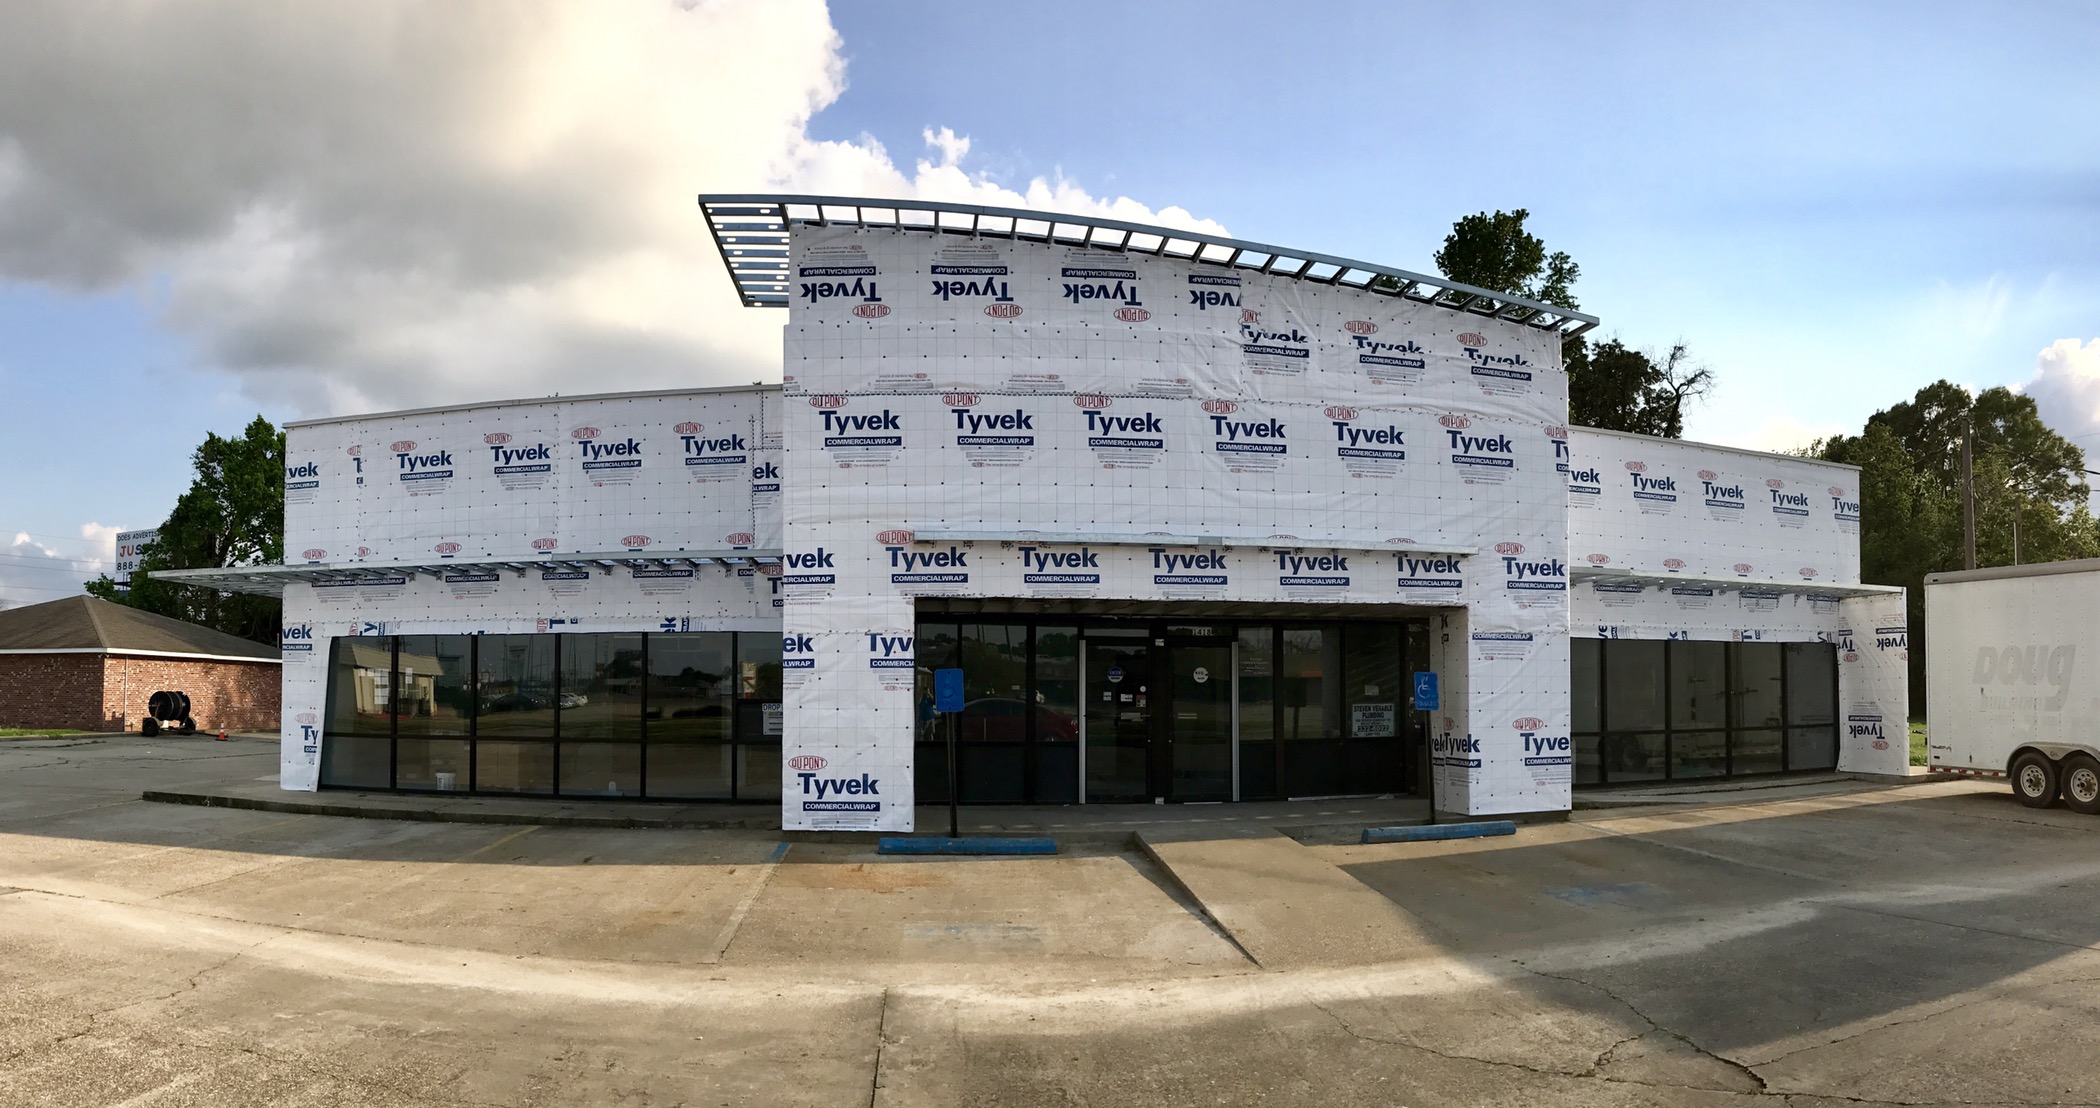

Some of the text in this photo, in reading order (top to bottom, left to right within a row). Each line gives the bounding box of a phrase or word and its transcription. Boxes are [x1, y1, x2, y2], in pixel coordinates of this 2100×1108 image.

[800, 278, 882, 302] Tyvek
[932, 277, 1013, 301] Tyvek
[1063, 281, 1142, 306] Tyvek
[1190, 290, 1241, 310] vek
[1353, 336, 1424, 354] Tyvek
[1360, 356, 1422, 368] COMMERCIALWRAP
[1464, 348, 1530, 367] Tyvek
[819, 410, 900, 435] Tyvek
[952, 409, 1033, 434] Tyvek
[1083, 410, 1162, 435] Tyvek
[1210, 415, 1286, 440] Tyvek
[826, 438, 897, 446] COMMERCIALWRAP
[959, 437, 1031, 445] COMMERCIALWRAP
[1090, 438, 1161, 448] COMMERCIALWRAP
[1333, 422, 1404, 446] Tyvek
[1447, 430, 1512, 453] Tyvek
[491, 444, 550, 464] Tyvek
[578, 438, 641, 460] Tyvek
[681, 434, 745, 456] Tyvek
[1217, 443, 1284, 453] COMMERCIALWRAP
[1339, 448, 1402, 459] COMMERCIALWRAP
[288, 462, 318, 478] vek
[397, 451, 451, 472] Tyvek
[495, 465, 549, 474] COMMERCIALWRAP
[583, 461, 640, 469] COMMERCIALWRAP
[686, 457, 744, 465] COMMERCIALWRAP
[1453, 456, 1511, 466] COMMERCIALWRAP
[1571, 468, 1600, 483] vek
[1630, 473, 1676, 491] Tyvek
[1703, 482, 1744, 499] Tyvek
[1770, 490, 1808, 506] Tyvek
[1832, 497, 1859, 513] Tyve
[133, 531, 157, 539] ADVERTIS
[120, 544, 142, 557] JUS
[784, 548, 834, 568] vek
[886, 547, 967, 571] Tyvek
[1018, 547, 1098, 572] Tyvek
[1148, 549, 1226, 573] Tyvek
[1274, 551, 1348, 575] Tyvek
[1393, 553, 1461, 576] Tyvek
[1502, 557, 1565, 579] Tyvek
[784, 575, 832, 583] ERCIALWRAP
[1156, 576, 1224, 584] COMMERCIALWRAP
[1281, 577, 1347, 585] COMMERCIALWRAP
[1399, 579, 1460, 587] COMMERCIALWRAP
[1508, 581, 1564, 590] COMMERCIALWRAP
[282, 624, 312, 639] vek
[865, 633, 914, 656] Tyv
[1972, 644, 2076, 712] Doug
[1849, 723, 1885, 739] Tyvek
[1444, 733, 1480, 755] Tyvek
[1520, 733, 1570, 755] Tyve
[798, 773, 879, 799] Tyvek
